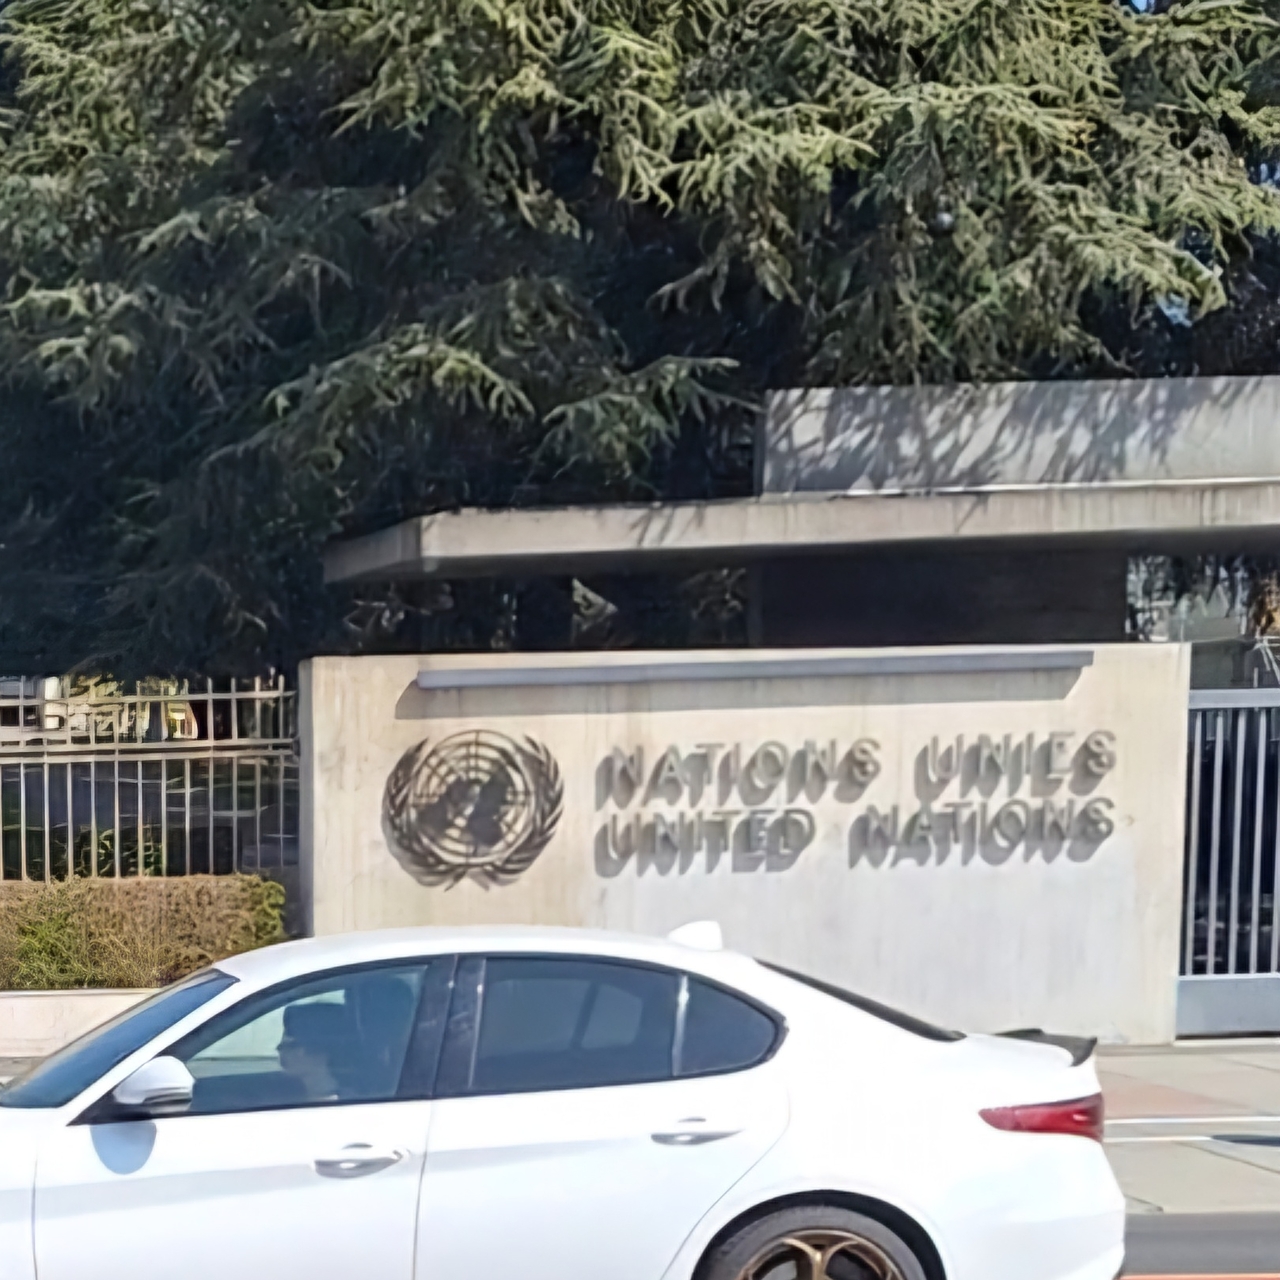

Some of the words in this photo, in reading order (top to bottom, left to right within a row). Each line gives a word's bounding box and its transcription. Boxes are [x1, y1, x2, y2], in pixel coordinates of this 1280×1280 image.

[604, 737, 881, 797] NATIONS
[922, 730, 1117, 791] UNIES
[602, 808, 816, 866] UNITED
[856, 797, 1115, 858] NATIONS
